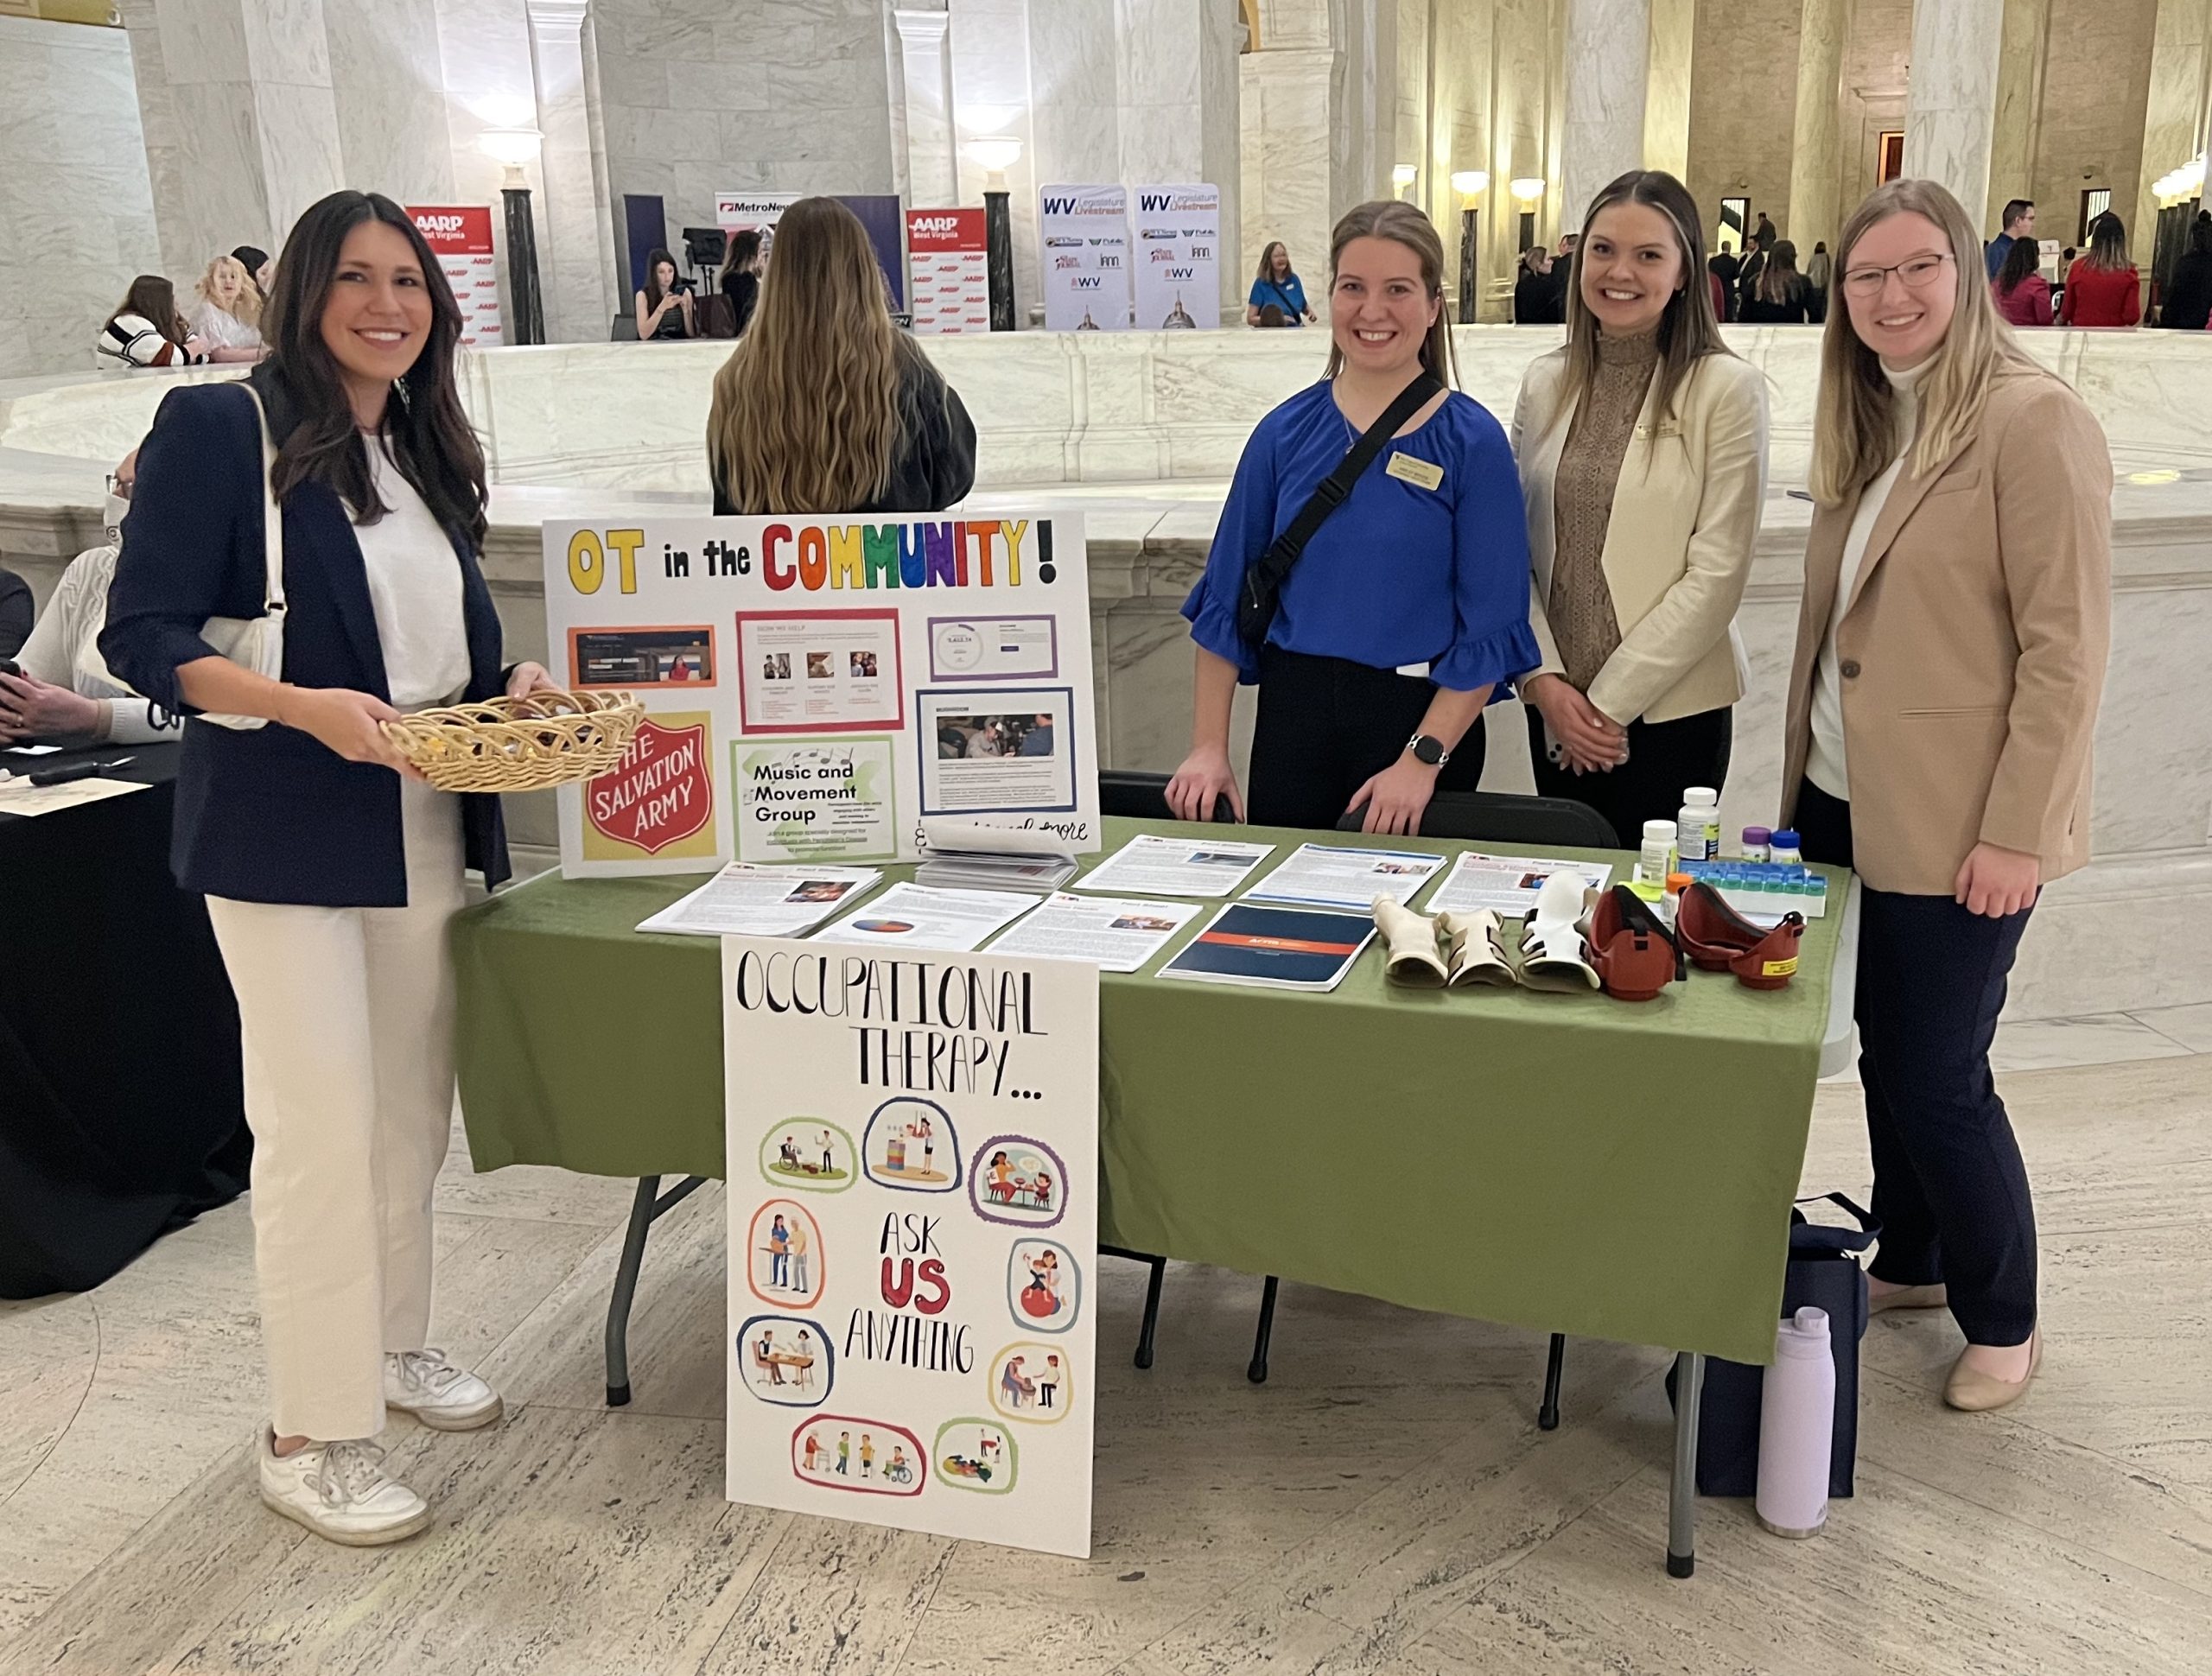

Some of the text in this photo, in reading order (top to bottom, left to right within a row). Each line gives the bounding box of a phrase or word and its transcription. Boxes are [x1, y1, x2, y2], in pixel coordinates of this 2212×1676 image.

[1044, 198, 1125, 214] WV Legislature
[1074, 206, 1124, 215] Livestream
[1141, 194, 1217, 211] WV Legislature
[1170, 202, 1217, 211] Livestream
[416, 215, 463, 232] AARP
[909, 218, 958, 232] AARP
[436, 232, 465, 241] Virginia
[931, 232, 958, 240] Virginia
[1172, 268, 1192, 277] WV
[1078, 276, 1100, 287] WV
[568, 520, 1056, 594] OT in the COMMUNITY!
[614, 733, 654, 775] HE
[595, 738, 695, 821] SALVATION
[753, 762, 854, 780] Music and
[754, 785, 856, 801] Movement
[633, 775, 693, 838] ARMY
[755, 807, 816, 825] Group
[737, 950, 1048, 1035] OCCUPATIONAL
[849, 1026, 1042, 1100] THERAPY...
[880, 1211, 942, 1257] ASK
[881, 1256, 950, 1315] US
[844, 1308, 974, 1374] ANYTHING
